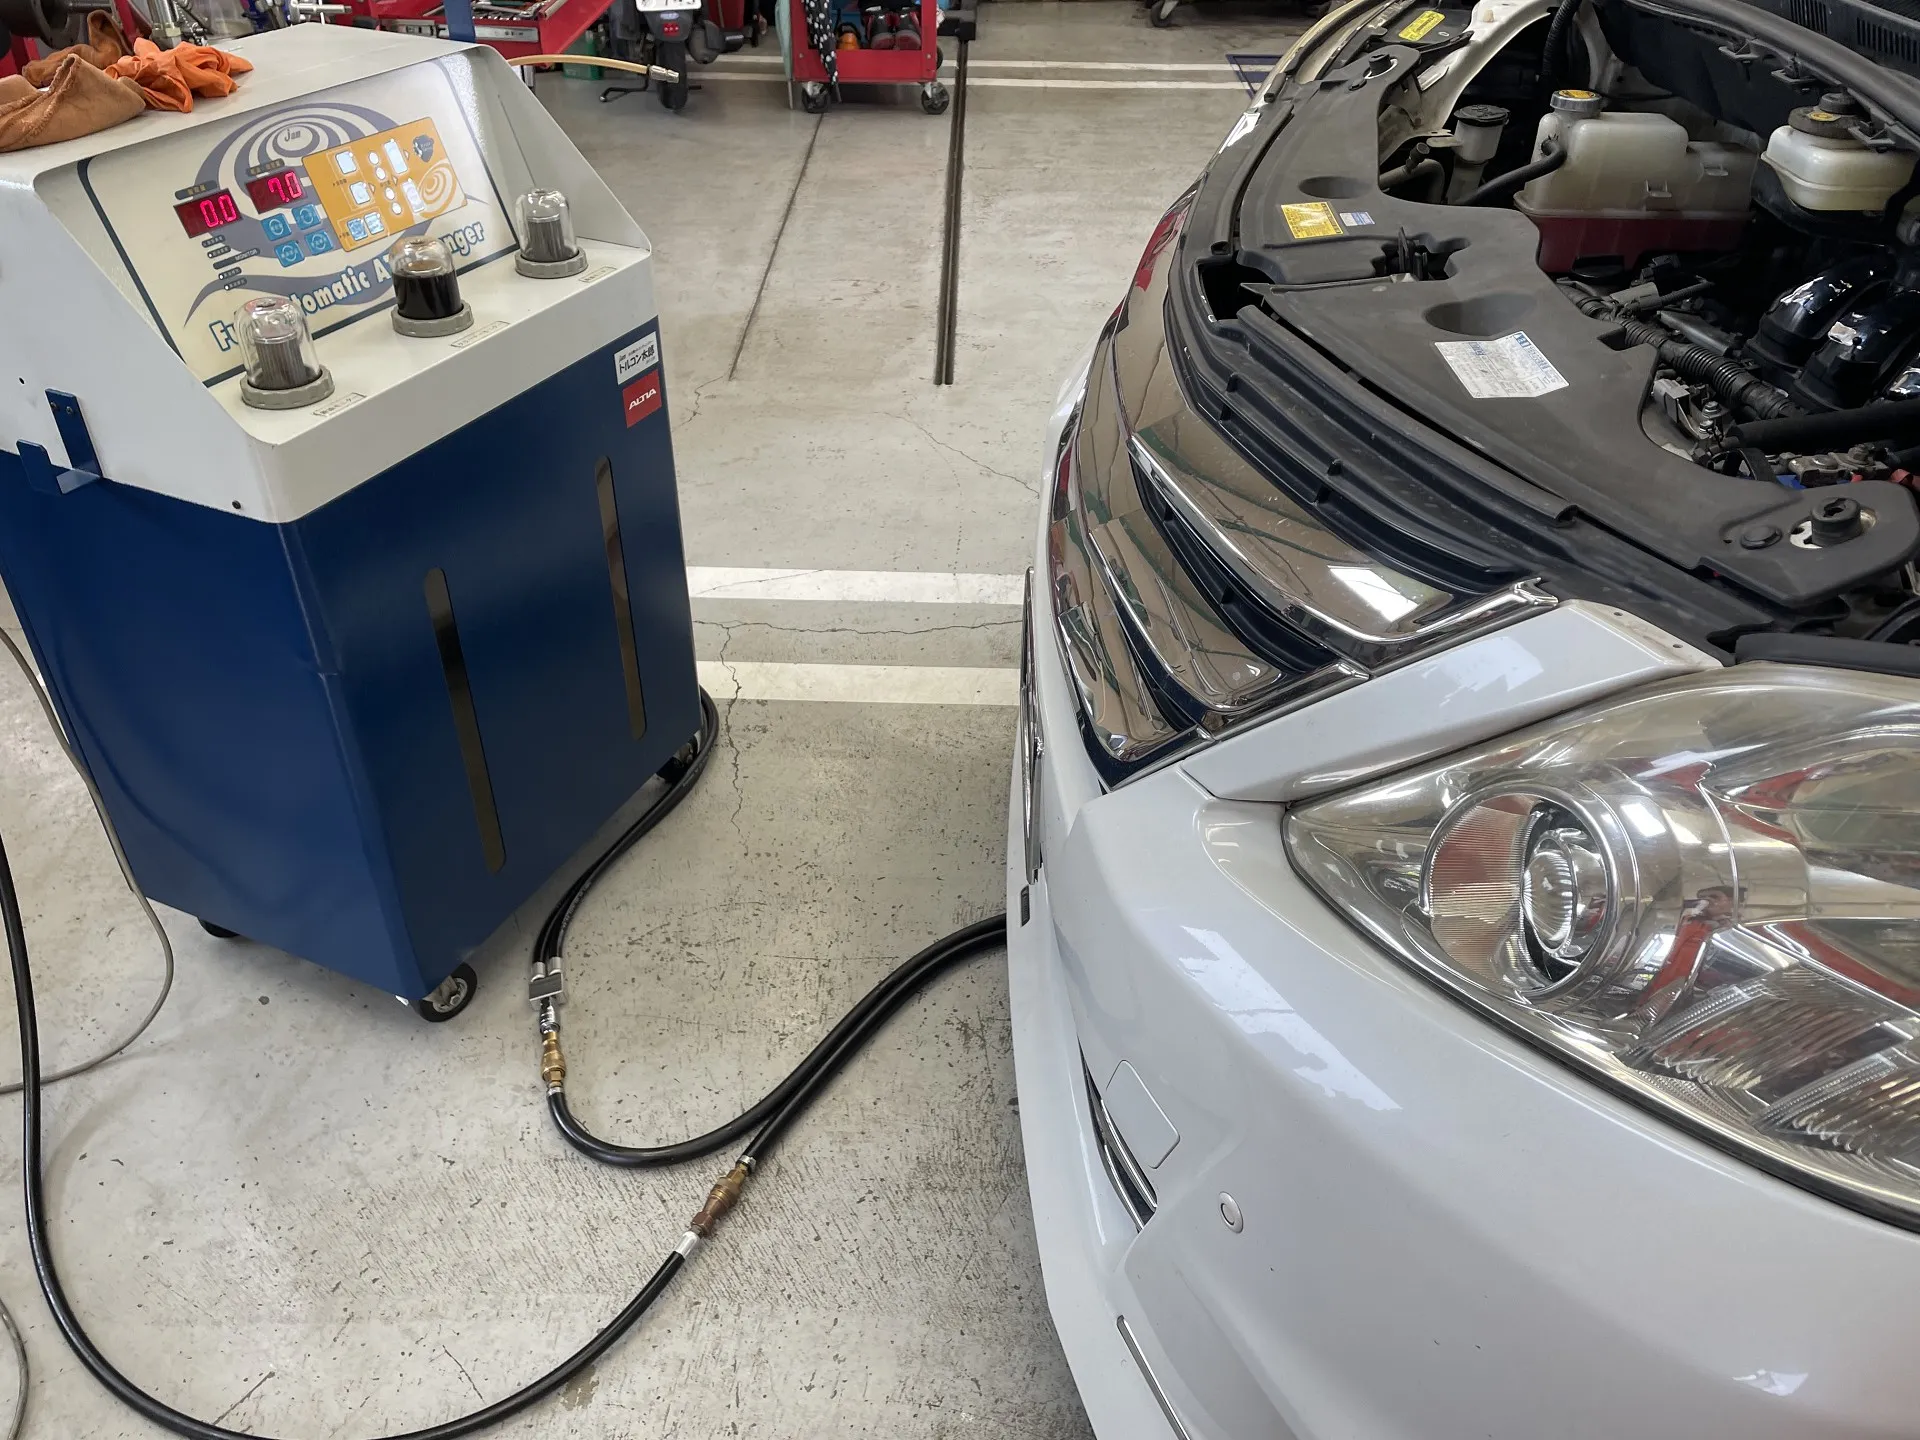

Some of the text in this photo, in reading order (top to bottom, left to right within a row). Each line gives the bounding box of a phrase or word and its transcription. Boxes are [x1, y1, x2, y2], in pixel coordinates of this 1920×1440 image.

[267, 171, 302, 203] 7.0
[200, 194, 237, 228] 0.0
[289, 265, 372, 317] tomatic
[628, 388, 657, 411] ALTIA
